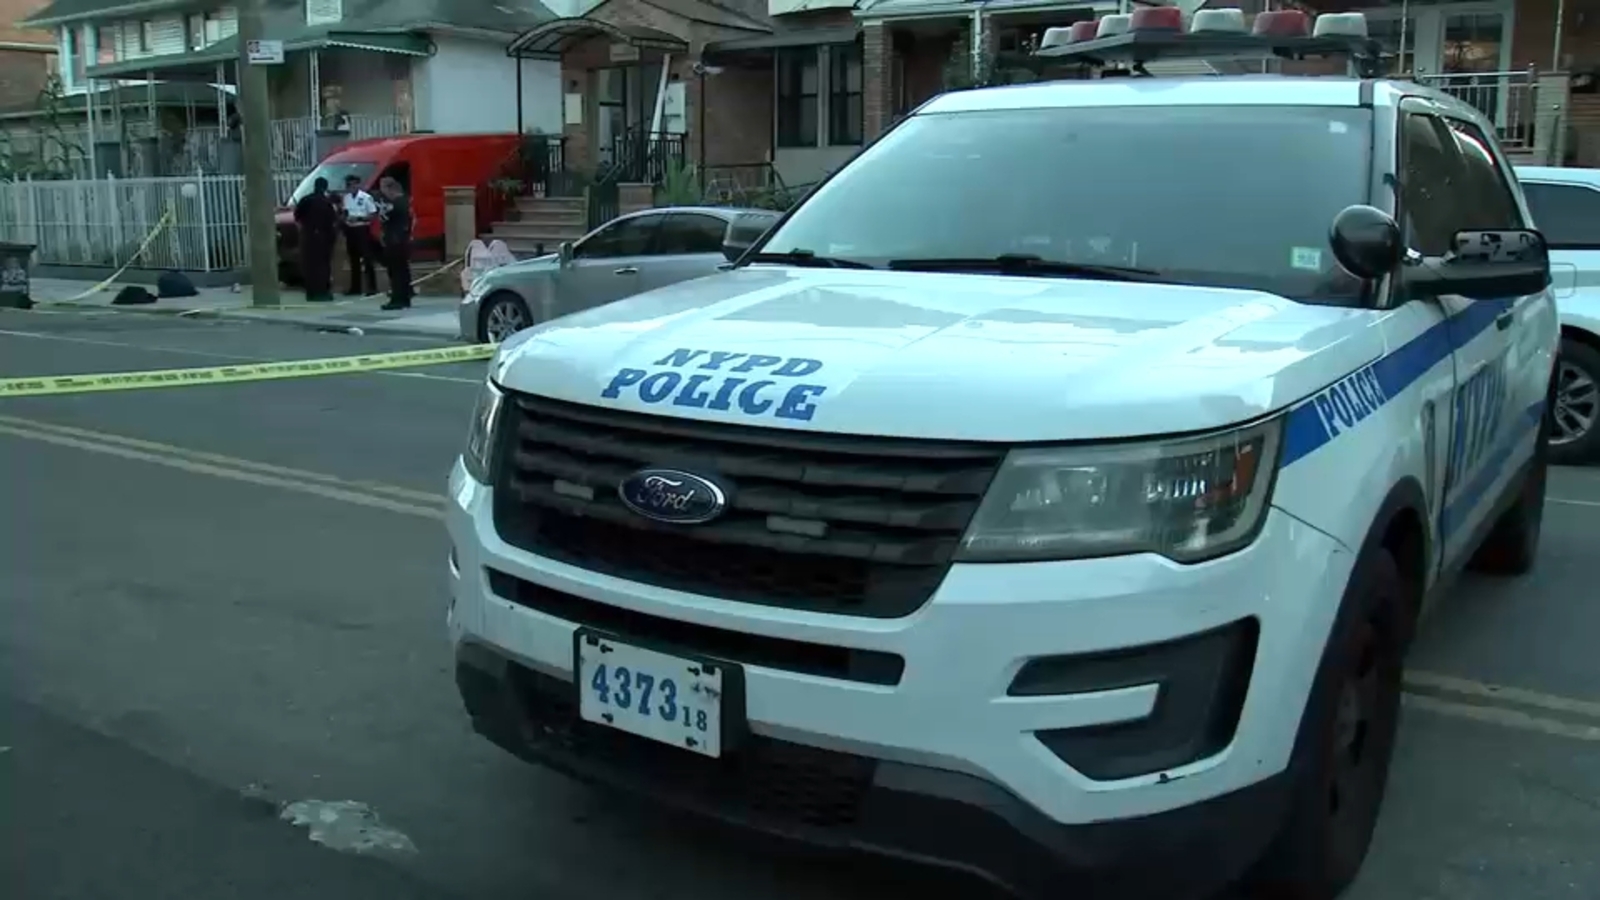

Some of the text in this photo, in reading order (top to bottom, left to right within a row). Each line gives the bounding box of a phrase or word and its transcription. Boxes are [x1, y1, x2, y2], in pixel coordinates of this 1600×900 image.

[653, 348, 823, 376] NYPD
[600, 368, 827, 421] POLICE
[1315, 366, 1386, 438] POLICE
[637, 476, 695, 511] Ford
[592, 663, 708, 732] 4373 18
